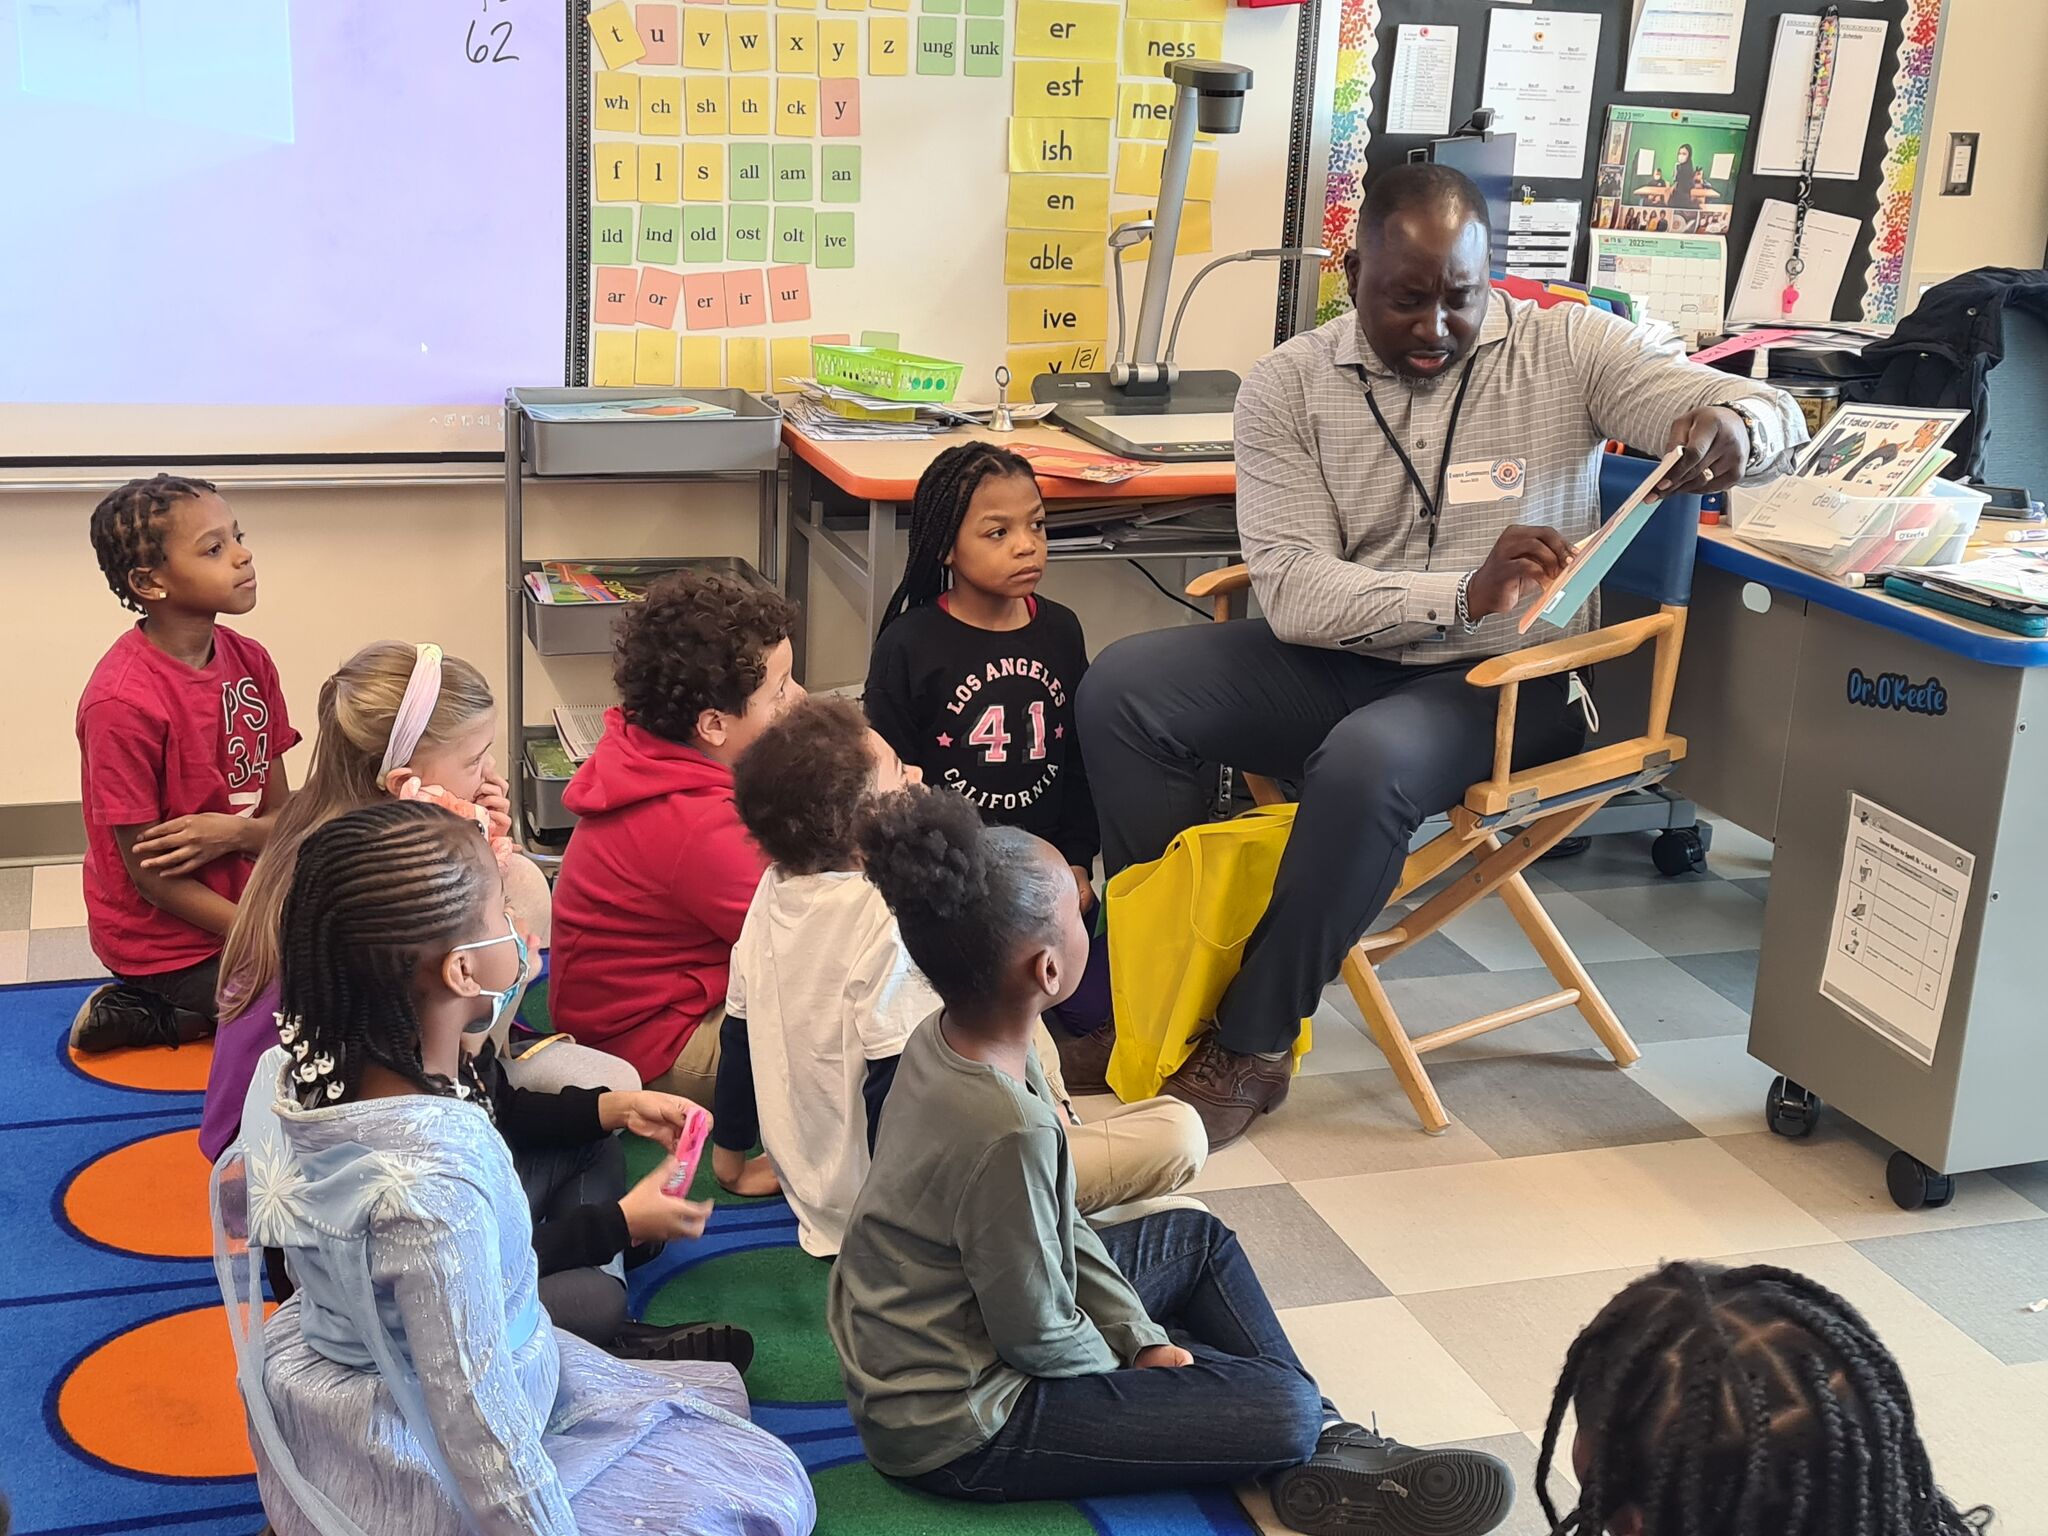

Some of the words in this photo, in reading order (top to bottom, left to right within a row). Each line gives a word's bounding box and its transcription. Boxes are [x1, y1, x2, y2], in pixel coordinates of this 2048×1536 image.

[611, 26, 624, 43] t
[650, 28, 665, 43] u
[1049, 22, 1077, 39] er
[465, 19, 520, 63] 62
[697, 32, 711, 47] v
[739, 34, 758, 49] w
[790, 37, 804, 51] x
[883, 40, 895, 54] z
[832, 42, 845, 62] y
[923, 41, 954, 58] ung
[970, 41, 999, 56] unk
[1148, 41, 1196, 58] ness
[1046, 66, 1084, 97] est
[604, 95, 629, 110] wh
[650, 98, 671, 114] ch
[696, 98, 717, 113] sh
[741, 98, 758, 113] th
[787, 100, 807, 115] ck
[834, 101, 847, 120] y
[1042, 129, 1072, 161] ish
[613, 160, 623, 180] f
[697, 165, 709, 180] s
[739, 164, 760, 179] all
[780, 169, 806, 180] am
[831, 170, 852, 181] an
[1047, 194, 1074, 210] en
[601, 228, 623, 244] ild
[646, 227, 673, 243] ind
[690, 226, 717, 241] old
[736, 227, 761, 241] ost
[783, 228, 804, 243] olt
[825, 234, 847, 248] ive
[1029, 243, 1073, 270] able
[607, 292, 626, 303] ar
[648, 293, 668, 306] or
[739, 292, 752, 306] ir
[781, 289, 799, 301] ur
[697, 297, 714, 309] er
[1043, 308, 1077, 329] ive
[947, 674, 982, 715] LOS
[986, 657, 1066, 708] ANGELES
[1850, 670, 1876, 704] Dr.
[1878, 675, 1946, 712] O'Keefe
[222, 677, 268, 735] PS
[968, 701, 1047, 763] 41
[228, 733, 269, 788] 34
[944, 763, 1059, 810] CALIFORNIA
